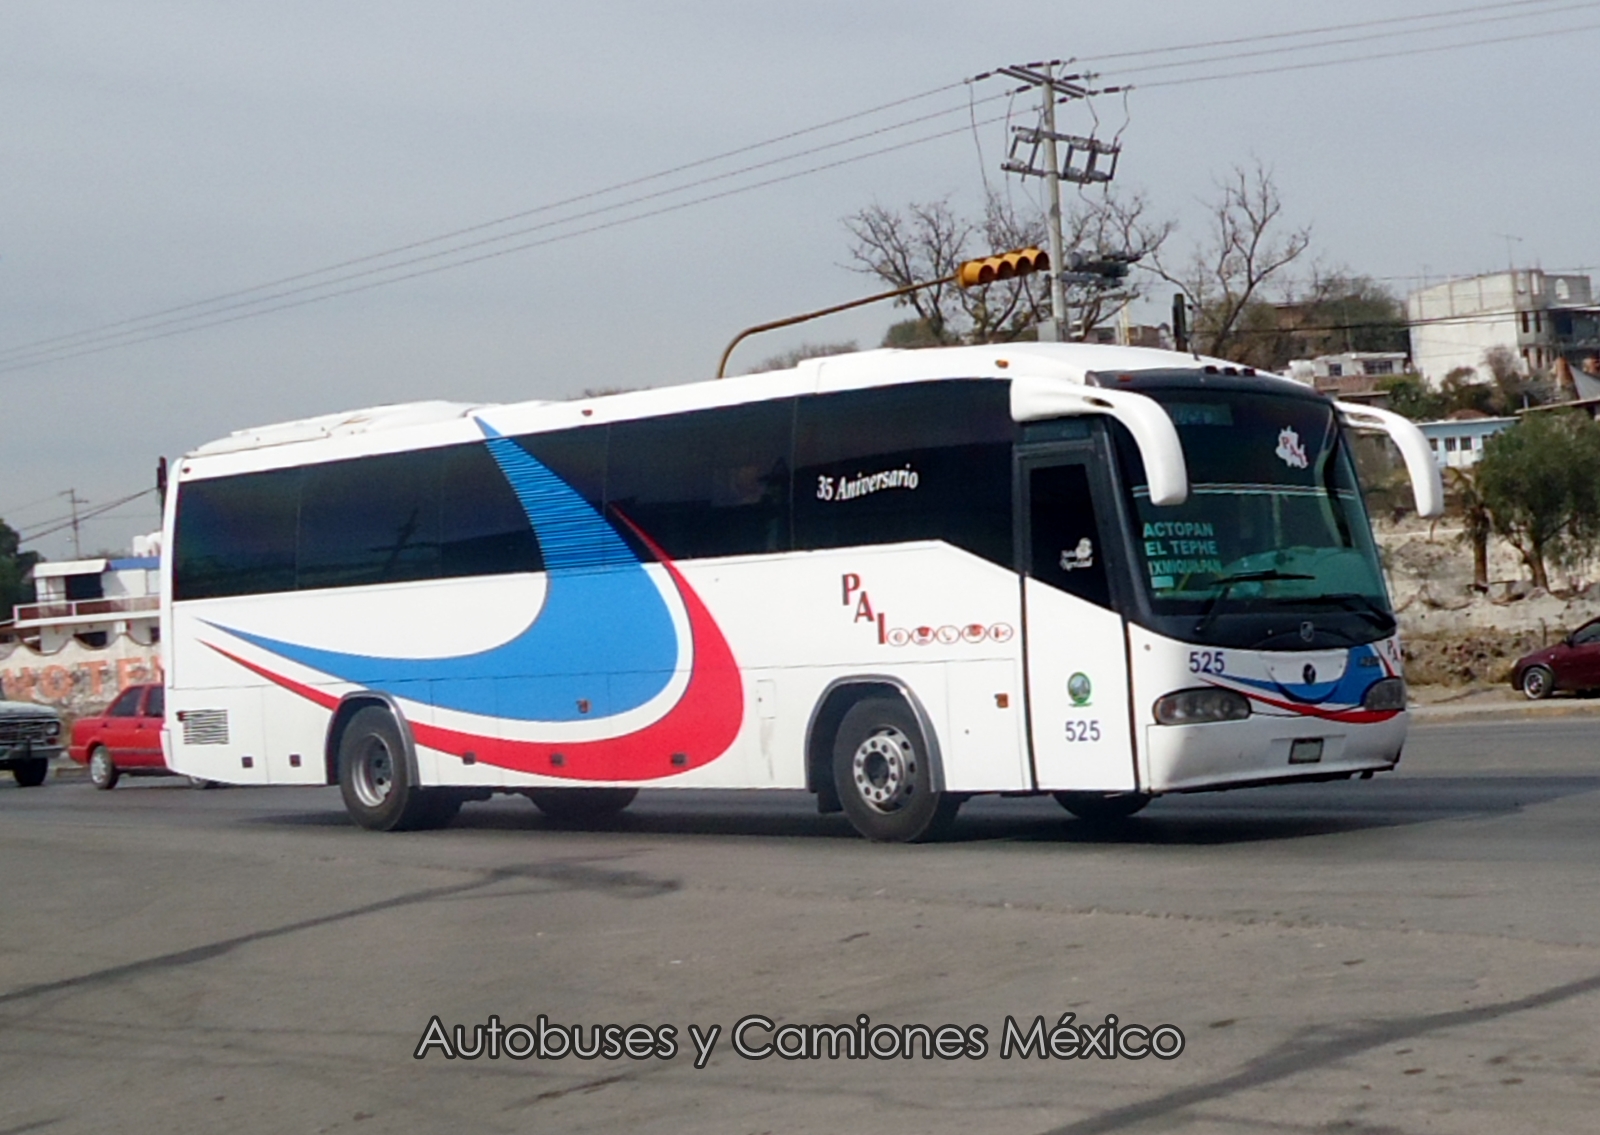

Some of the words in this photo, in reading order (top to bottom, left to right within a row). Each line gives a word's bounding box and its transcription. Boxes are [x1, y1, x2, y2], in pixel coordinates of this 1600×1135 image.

[816, 475, 833, 501] 35
[835, 464, 920, 501] Aniversario
[1143, 521, 1214, 538] ACTOPAN
[1145, 541, 1167, 556] EL
[1169, 540, 1218, 556] TEPHE
[841, 573, 886, 645] PAI
[1189, 652, 1225, 674] 525
[1064, 720, 1101, 742] 525
